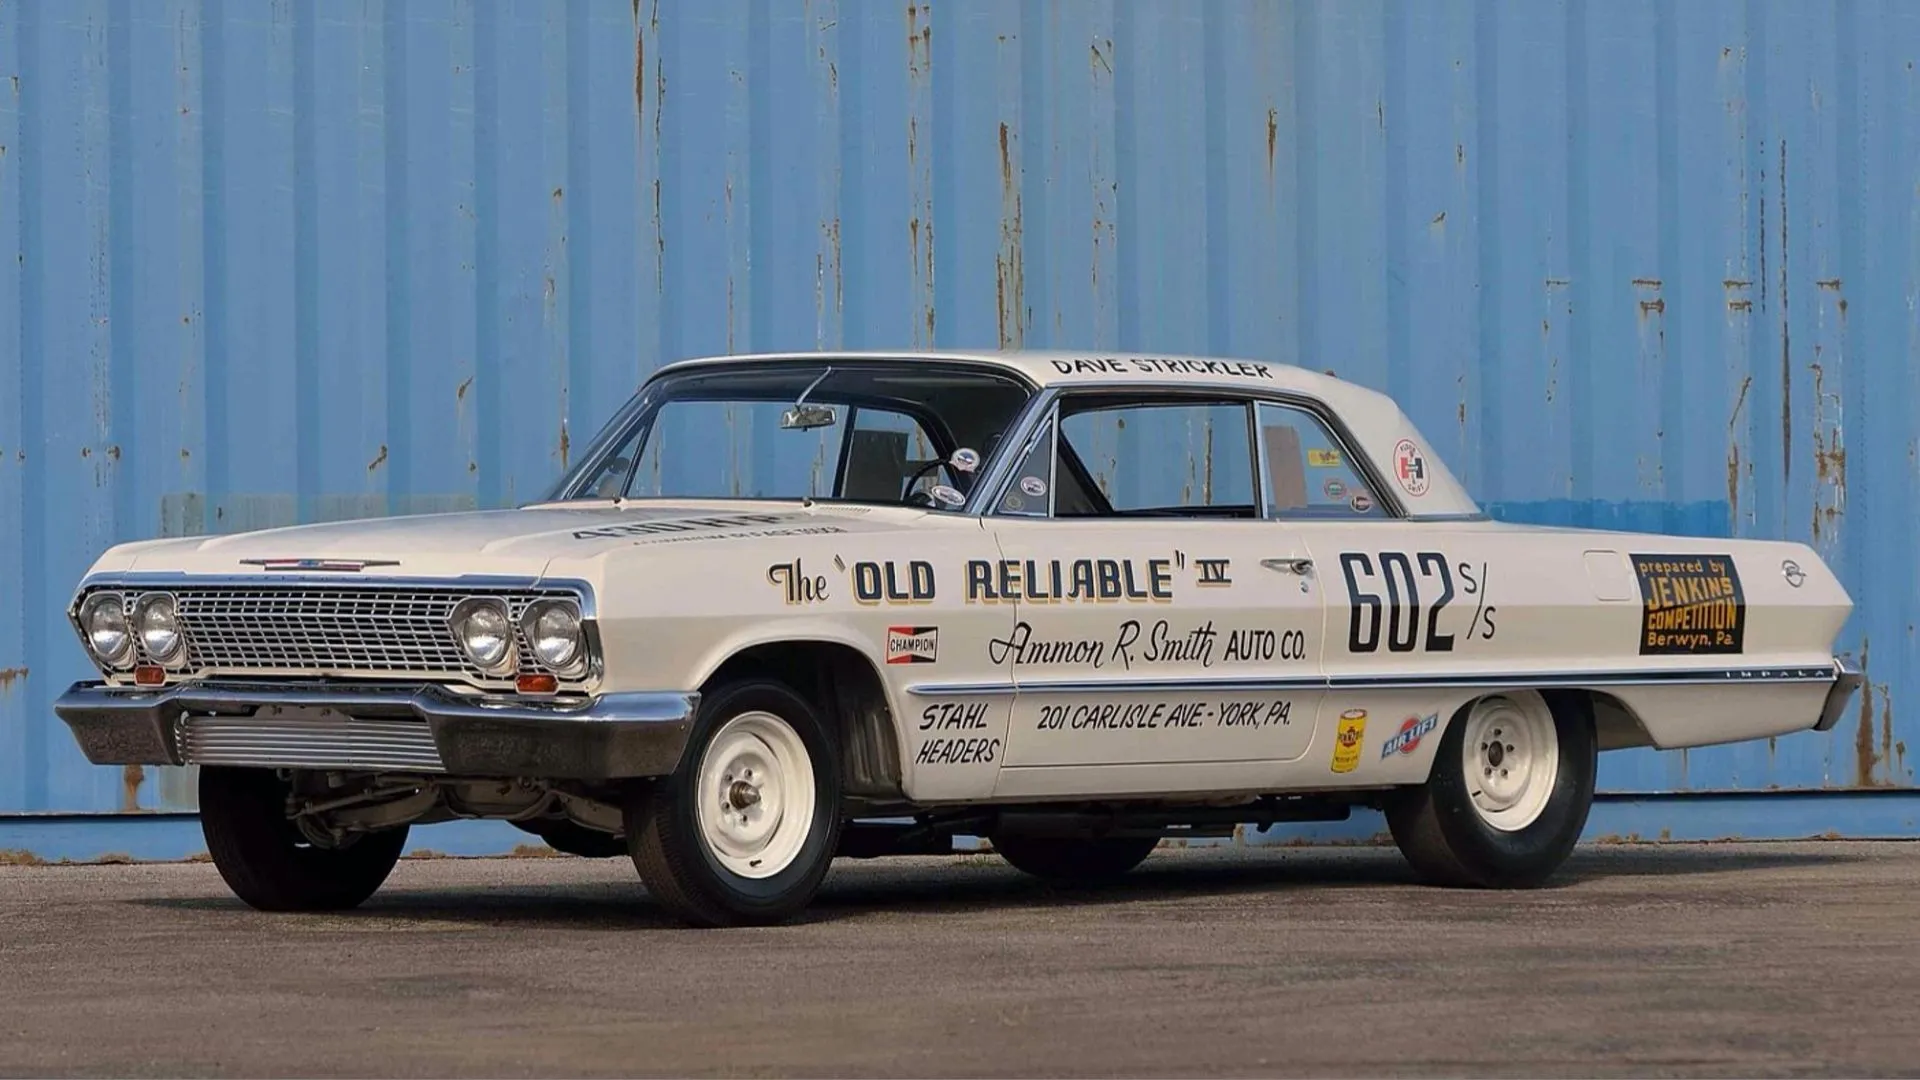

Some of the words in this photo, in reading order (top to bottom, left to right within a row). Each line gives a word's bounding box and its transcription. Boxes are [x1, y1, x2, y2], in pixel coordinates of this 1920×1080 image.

[1050, 358, 1129, 375] DAVE
[1130, 358, 1275, 379] STRICKLER
[765, 557, 830, 605] The
[1640, 558, 1704, 577] prepared
[1709, 559, 1725, 576] by
[1339, 552, 1455, 652] 602
[1648, 576, 1734, 611] JENKINS
[1648, 597, 1737, 629] COMPETITION
[890, 638, 934, 652] CHAMPION
[988, 620, 1105, 669] Ammon
[1111, 619, 1140, 670] R.
[1143, 619, 1217, 668] Smith
[1223, 630, 1277, 661] AUTO
[1281, 630, 1306, 660] CO.
[1648, 631, 1711, 649] Berwyn,
[919, 702, 989, 730] STAHL
[1037, 705, 1068, 730] 201
[1069, 702, 1162, 730] CARLISLE
[1164, 702, 1206, 729] AVE.
[1217, 701, 1264, 729] YORK,
[1263, 700, 1291, 726] PA.
[915, 738, 1000, 765] HEADERS
